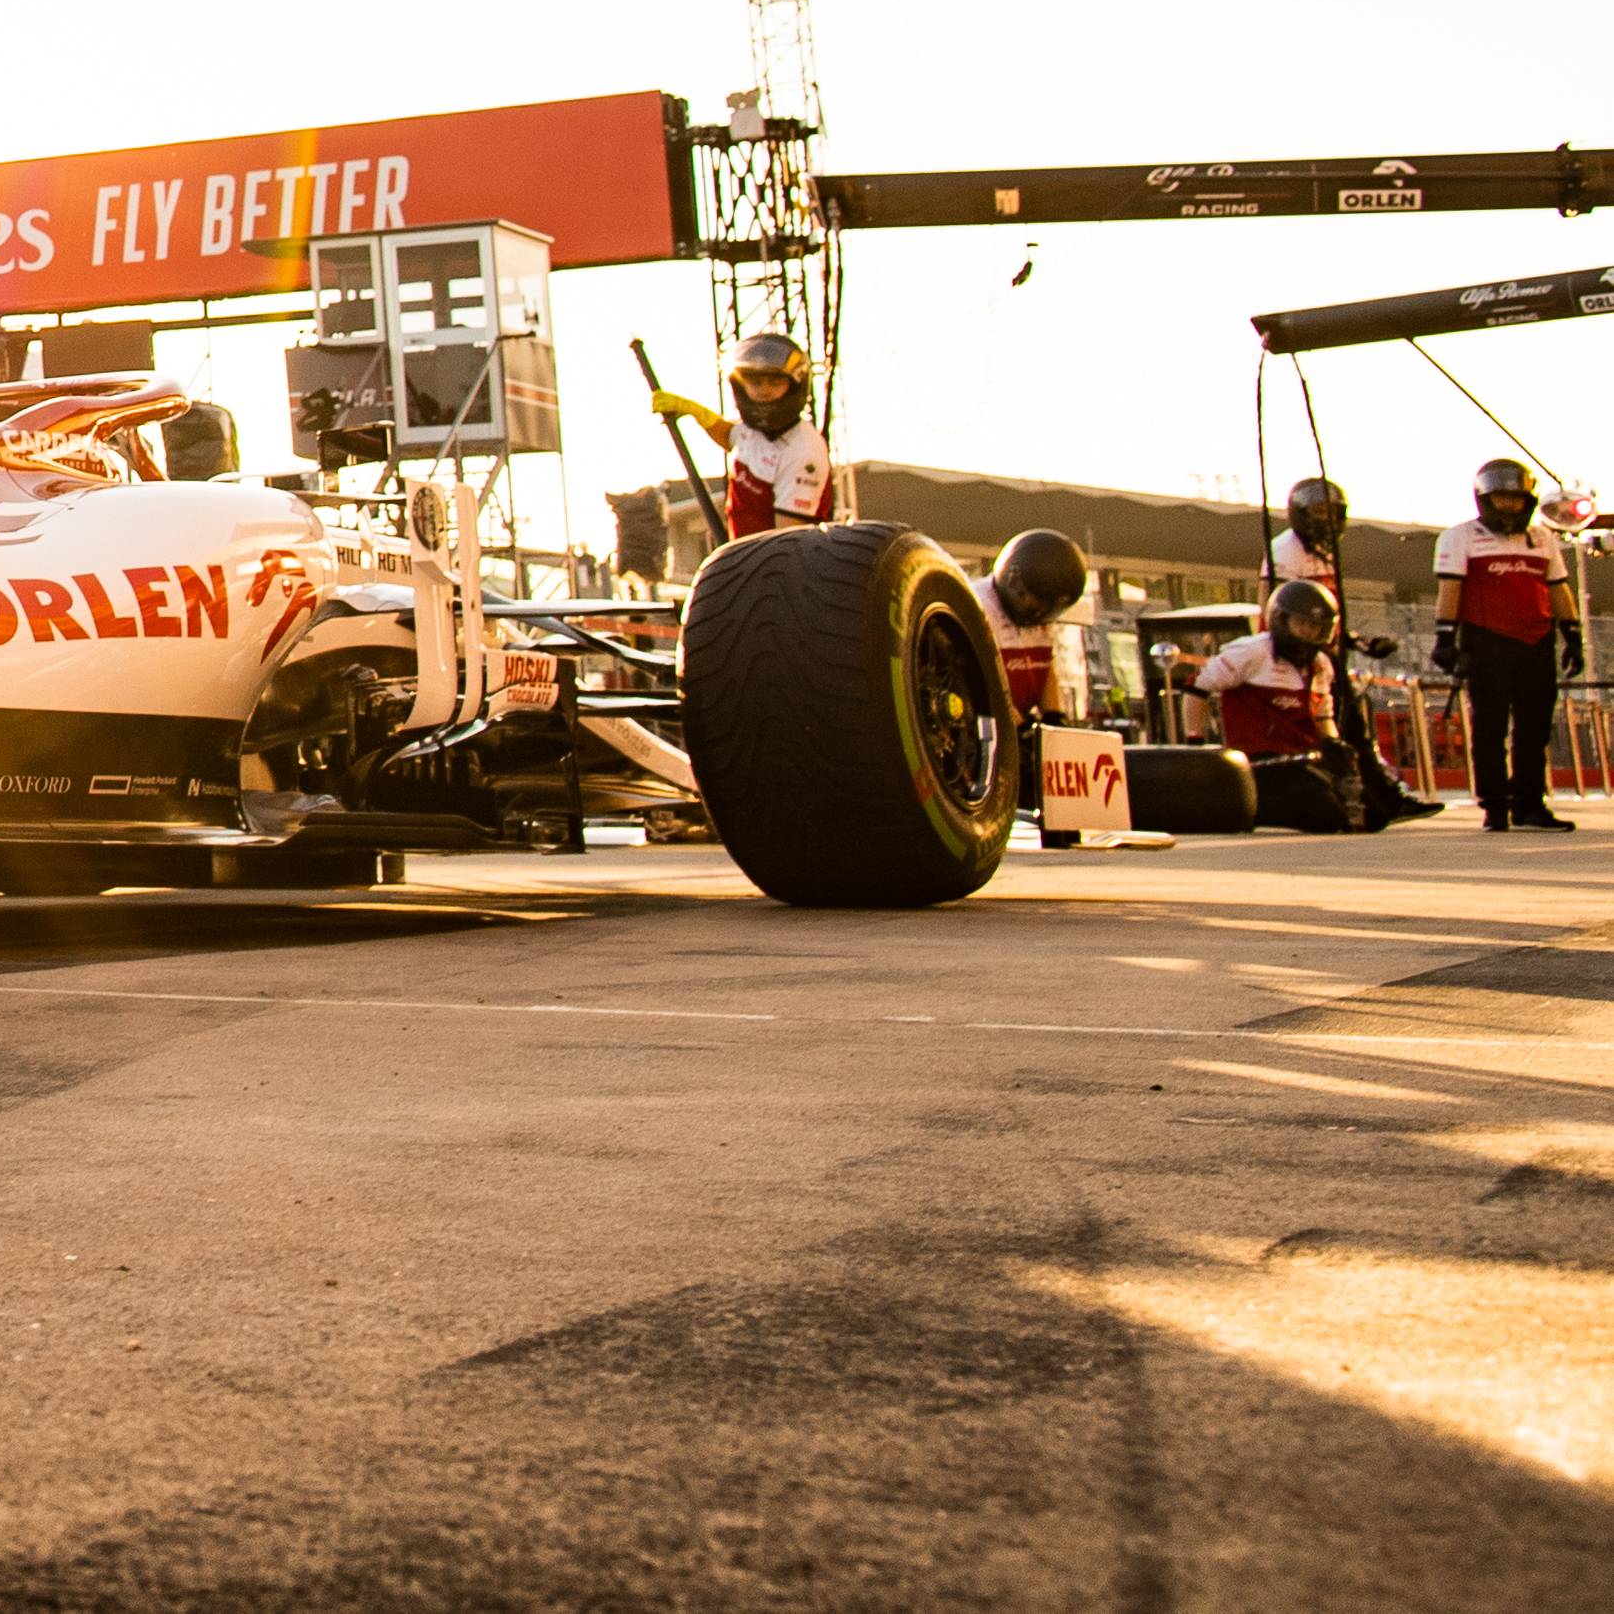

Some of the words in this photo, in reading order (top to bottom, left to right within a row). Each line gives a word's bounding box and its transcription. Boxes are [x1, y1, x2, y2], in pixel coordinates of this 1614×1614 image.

[1180, 202, 1260, 218] RACING
[1343, 193, 1416, 209] ORLEN
[91, 180, 180, 267] FLY
[201, 155, 412, 259] BETTER
[506, 688, 553, 706] CHOCOLATE
[1042, 760, 1089, 798] RLEN
